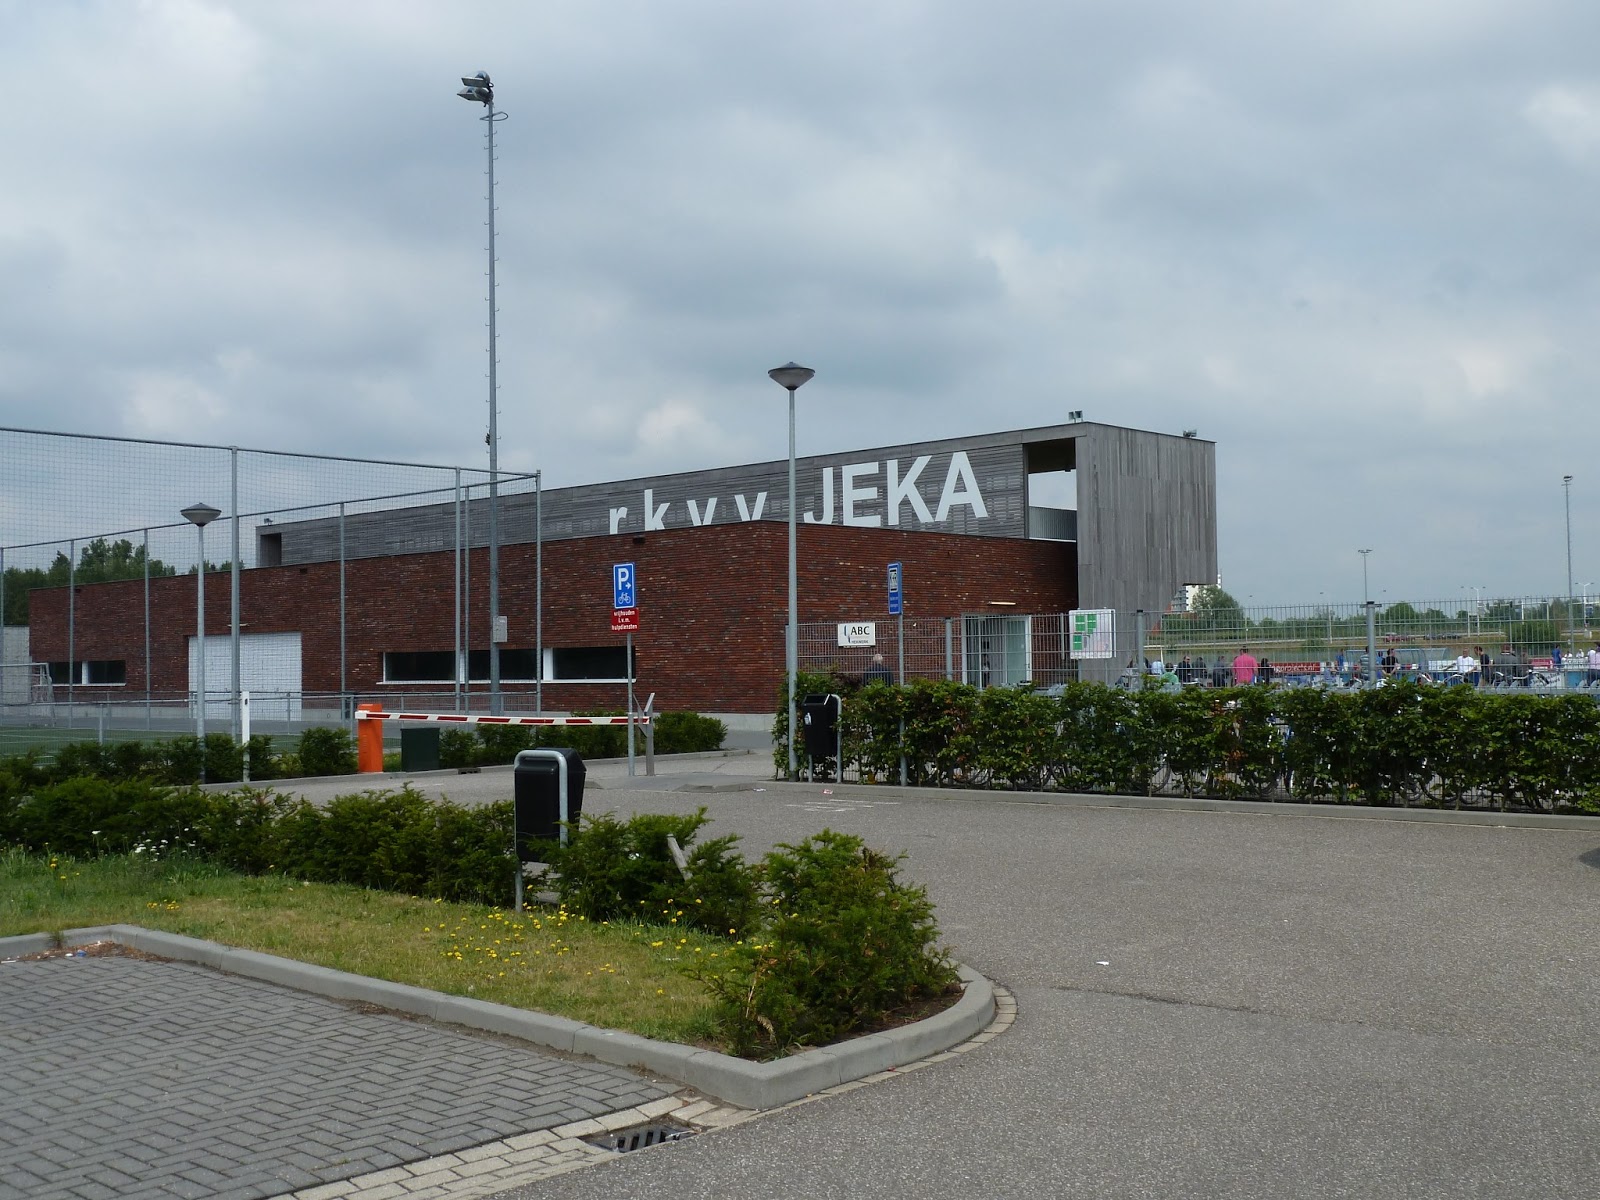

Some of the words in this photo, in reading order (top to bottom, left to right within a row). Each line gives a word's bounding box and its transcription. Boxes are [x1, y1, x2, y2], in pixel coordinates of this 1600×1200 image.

[803, 452, 989, 528] JEKA
[617, 567, 630, 591] P
[850, 626, 870, 635] ABC
